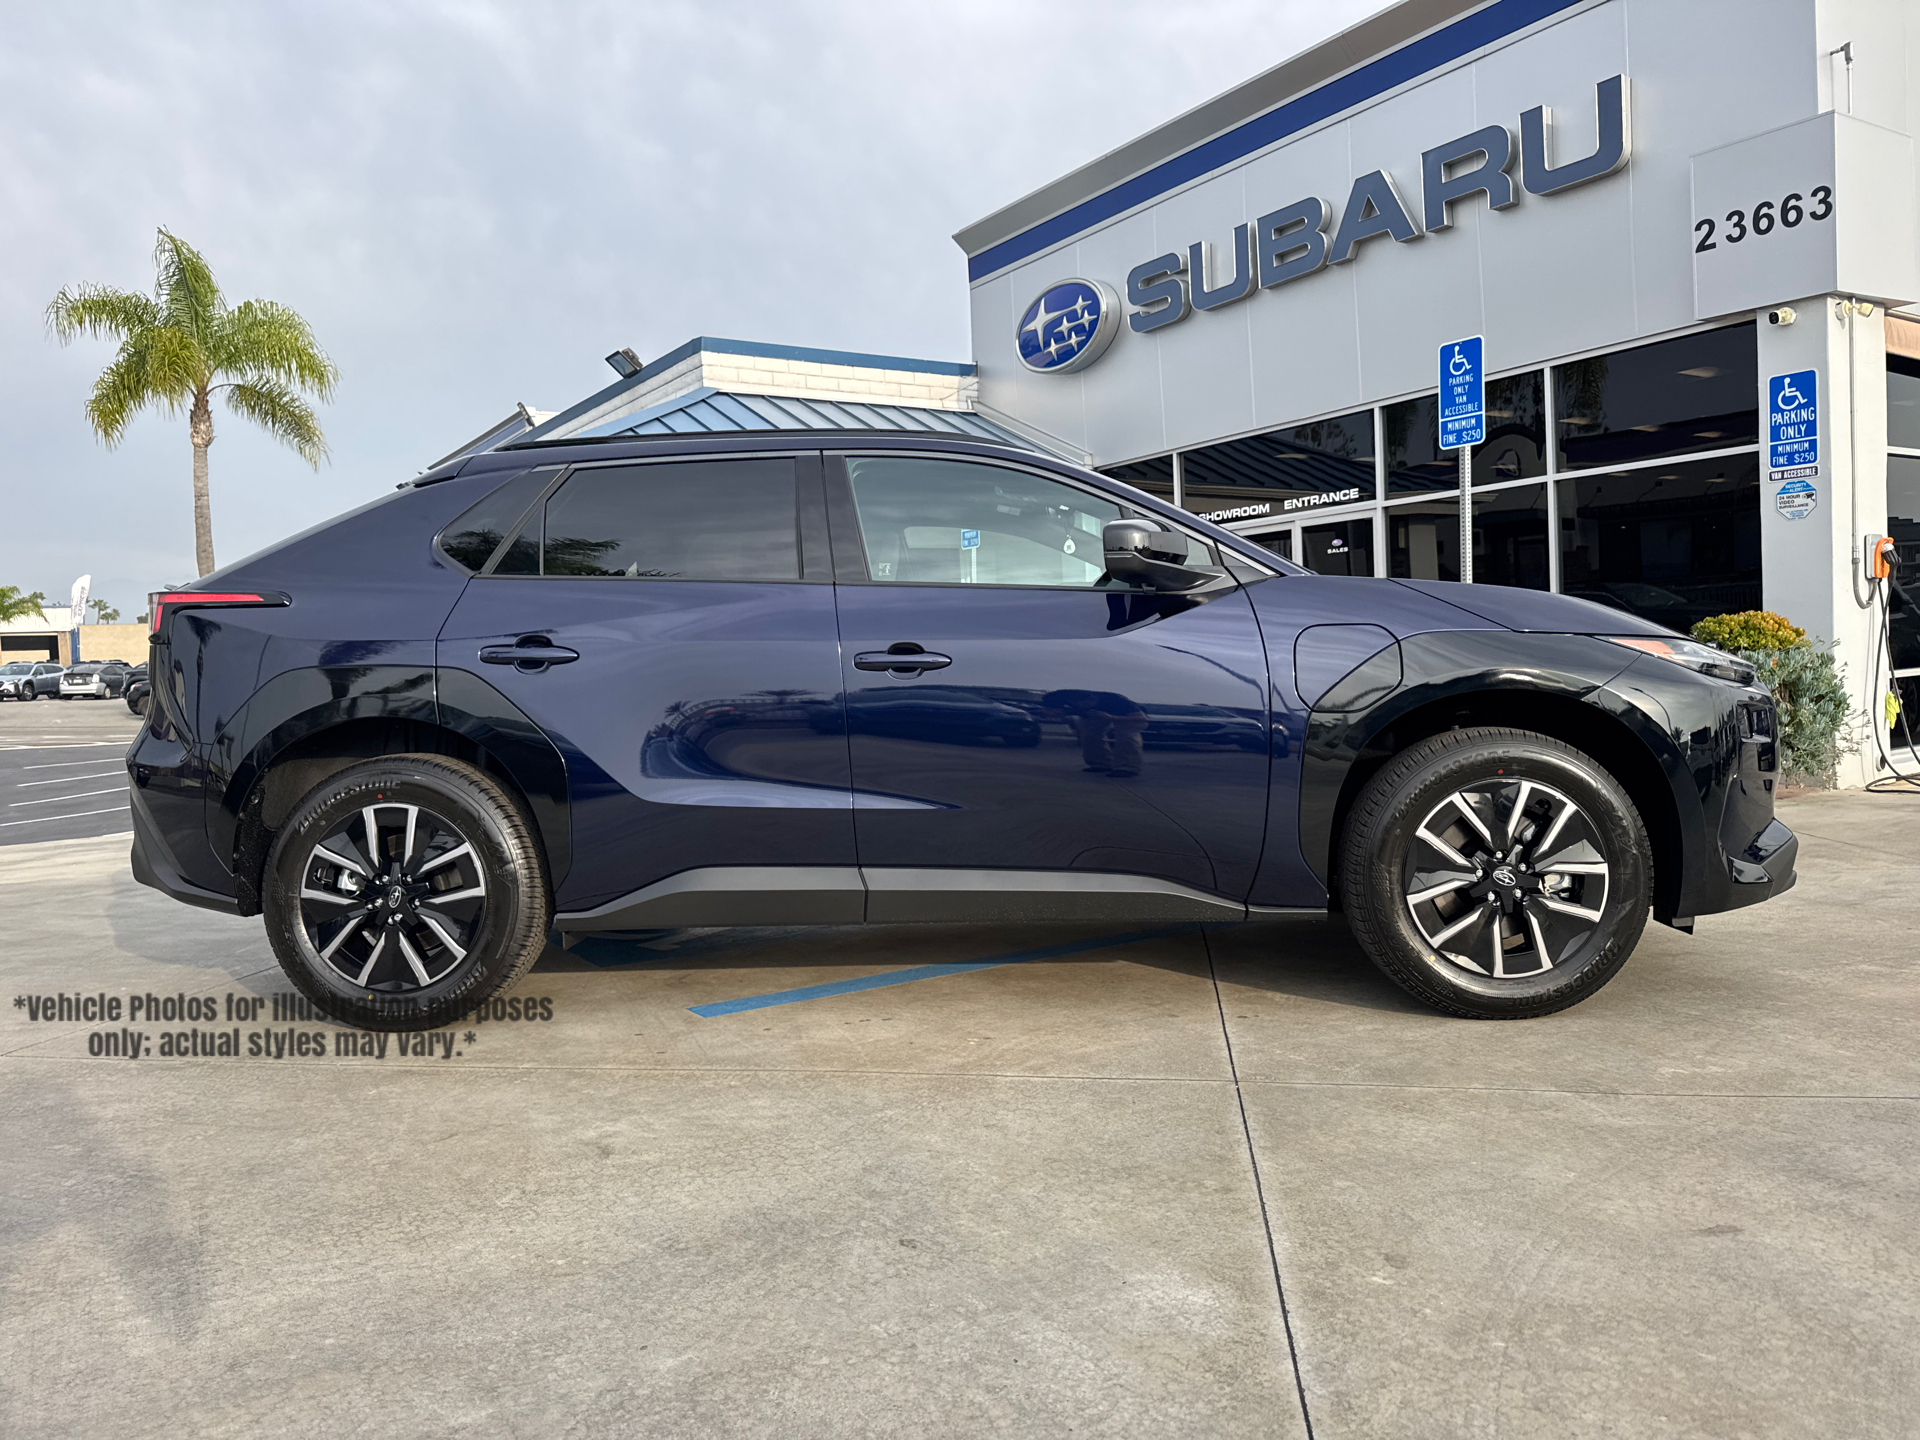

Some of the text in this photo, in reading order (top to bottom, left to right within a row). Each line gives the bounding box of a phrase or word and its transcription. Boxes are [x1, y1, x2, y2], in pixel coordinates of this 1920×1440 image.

[1125, 73, 1632, 333] SUBARU
[1694, 185, 1834, 253] 23663
[1448, 373, 1474, 386] PARKING
[1453, 385, 1469, 395] ONLY
[1455, 395, 1467, 404] VAN
[1444, 402, 1479, 416] ACCESSIBLE
[1447, 417, 1476, 432] MINIMUM
[1771, 407, 1815, 427] PARKING
[1443, 428, 1481, 445] FINE $250
[1780, 424, 1807, 440] ONLY
[1777, 441, 1809, 454] MINIMUM
[1772, 451, 1815, 466] FINE $250
[1771, 467, 1816, 480] VAN ACCESSIBLE
[1199, 488, 1360, 521] SHOWROOM ENTRANCE
[1327, 546, 1349, 554] SALES
